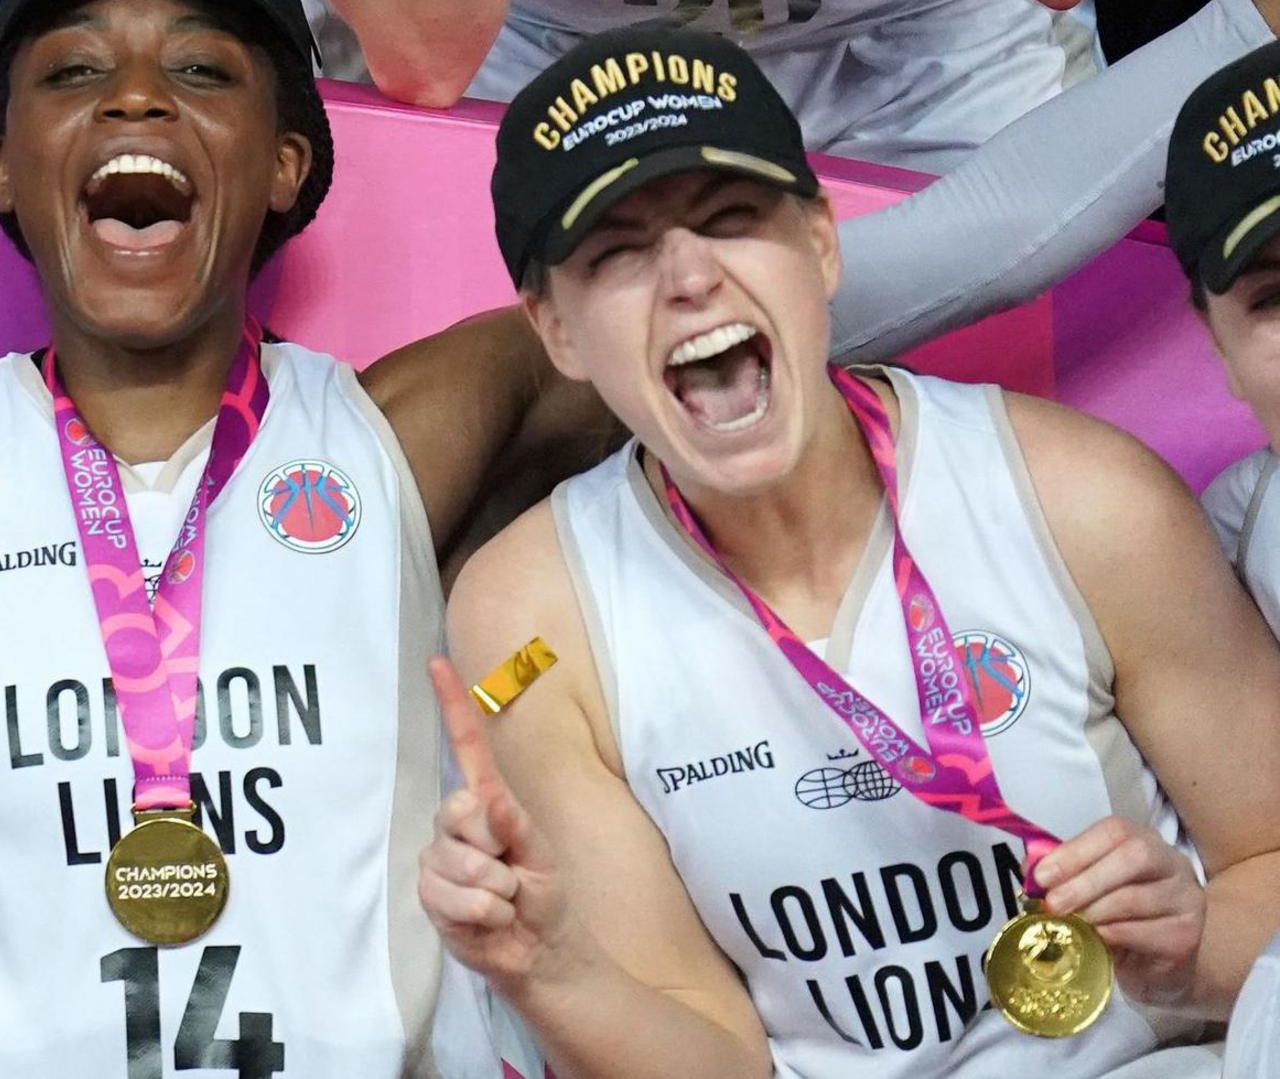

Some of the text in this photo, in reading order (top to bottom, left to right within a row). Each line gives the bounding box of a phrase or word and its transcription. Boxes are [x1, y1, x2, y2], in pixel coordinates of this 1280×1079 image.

[533, 51, 737, 152] CHAMPIONS
[563, 94, 723, 152] EUROCUP WOMEN
[1231, 129, 1280, 167] EURO
[71, 449, 104, 535] WOMEN
[88, 449, 127, 549] EUROCUP
[4, 663, 322, 770] LOON
[916, 633, 948, 724] WOMEN
[927, 627, 973, 736] EUROCUP
[57, 766, 286, 867] LINS
[657, 740, 775, 794] SPALDING
[115, 865, 218, 883] CHAMPIONS
[118, 882, 216, 900] 2023/2024
[729, 842, 1028, 962] LONDON
[100, 945, 285, 1079] 14
[806, 949, 991, 1051] LION
